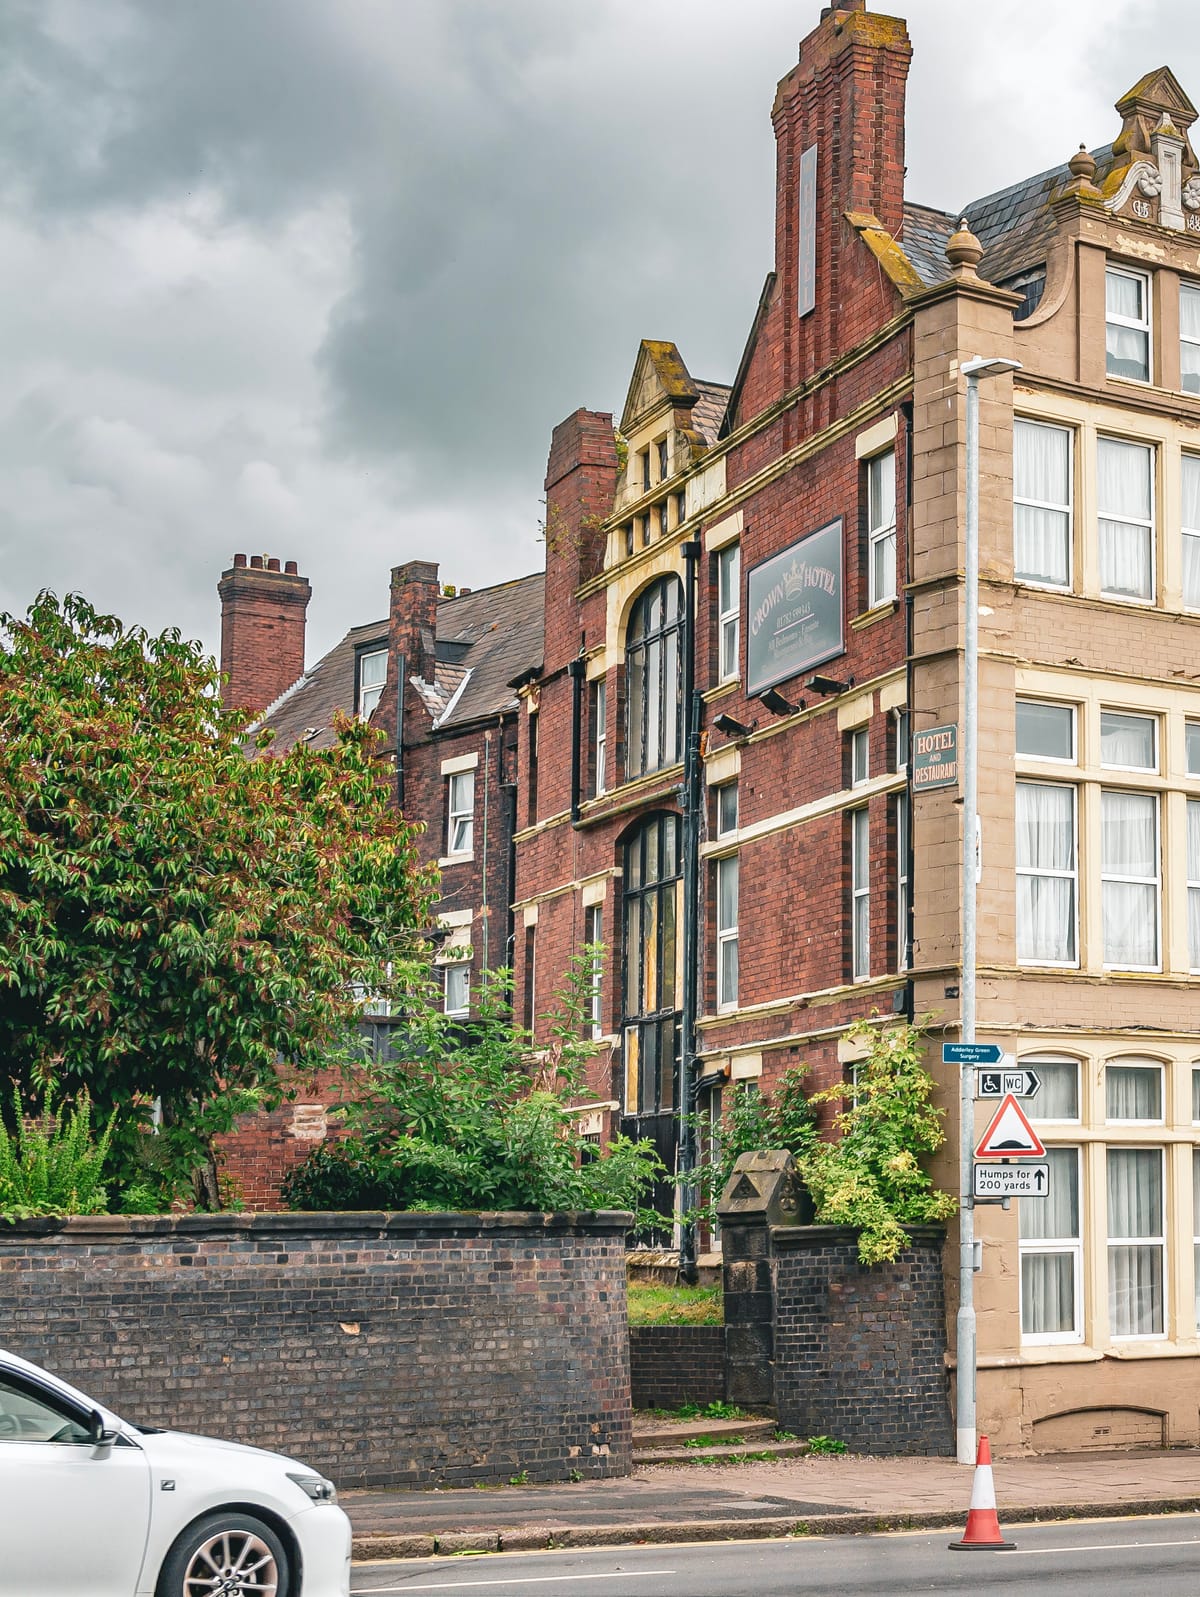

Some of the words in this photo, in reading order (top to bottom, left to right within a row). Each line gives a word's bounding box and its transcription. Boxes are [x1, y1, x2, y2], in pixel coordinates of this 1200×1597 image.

[751, 579, 785, 637] CROWN
[804, 566, 836, 596] HOTEL
[917, 731, 955, 755] HOTEL
[929, 753, 942, 763] AND
[915, 762, 957, 784] RESTAURANT
[1005, 1078, 1021, 1090] WC
[979, 1169, 1014, 1179] Humps
[1017, 1169, 1031, 1179] for
[979, 1181, 1001, 1190] 200
[1004, 1180, 1031, 1191] yards
